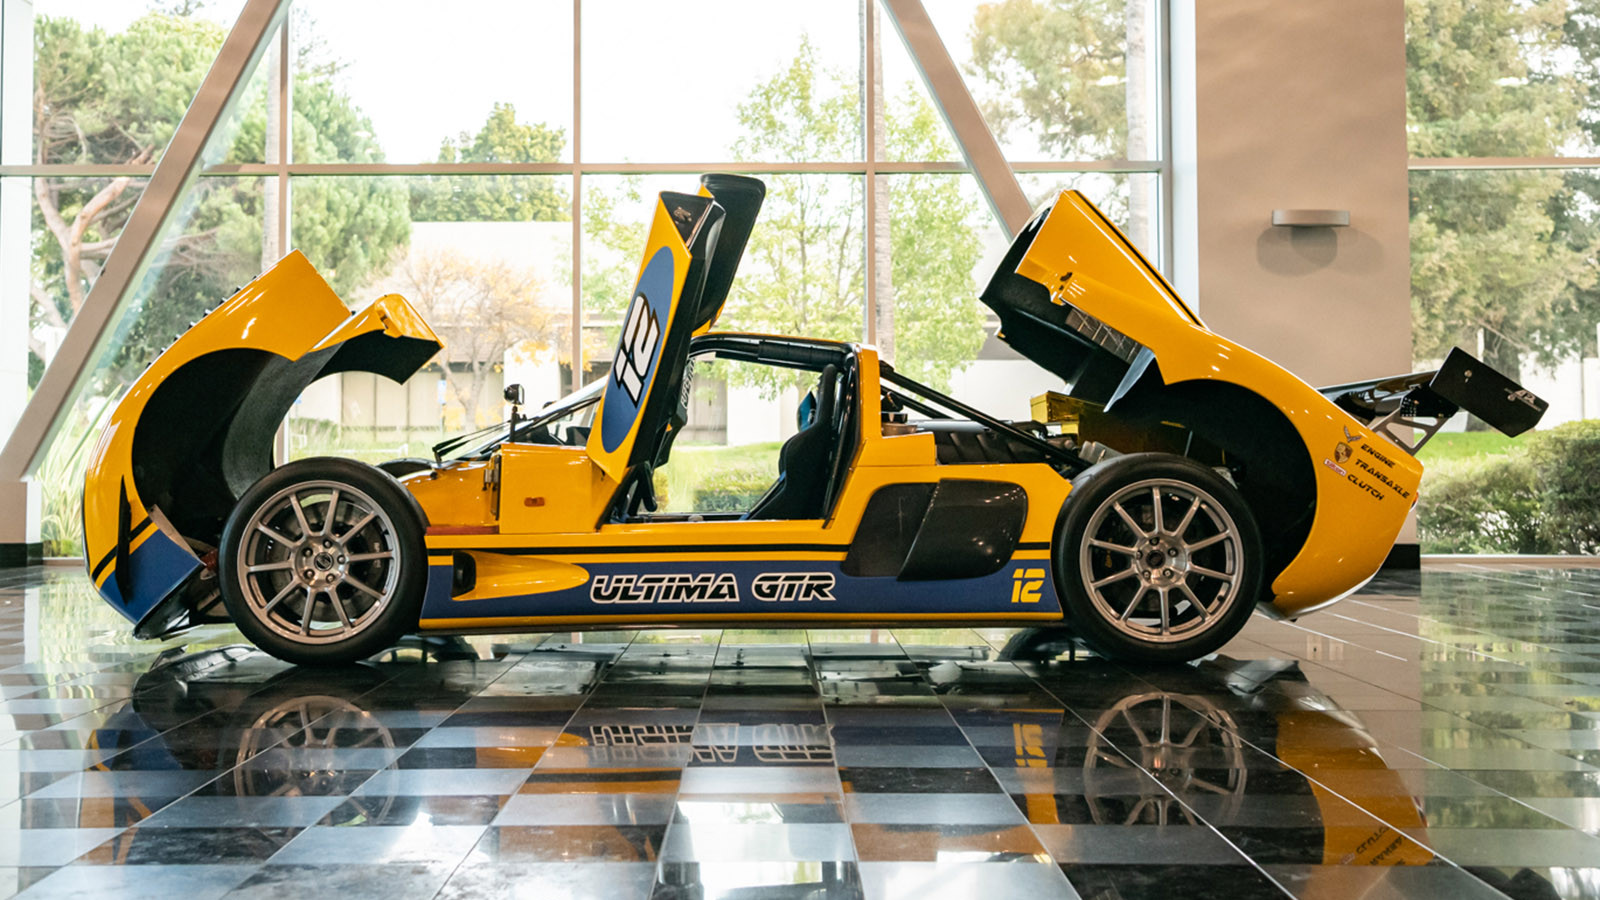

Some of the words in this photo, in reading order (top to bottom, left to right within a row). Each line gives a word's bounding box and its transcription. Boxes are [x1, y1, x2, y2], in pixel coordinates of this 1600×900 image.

[614, 292, 661, 408] 12
[1361, 444, 1396, 468] ENGINE
[1347, 475, 1385, 500] CLUTCH
[1355, 459, 1410, 499] TRANSAXLE
[590, 573, 739, 603] ULTIMA
[752, 572, 836, 601] GTR
[1012, 569, 1045, 603] 12
